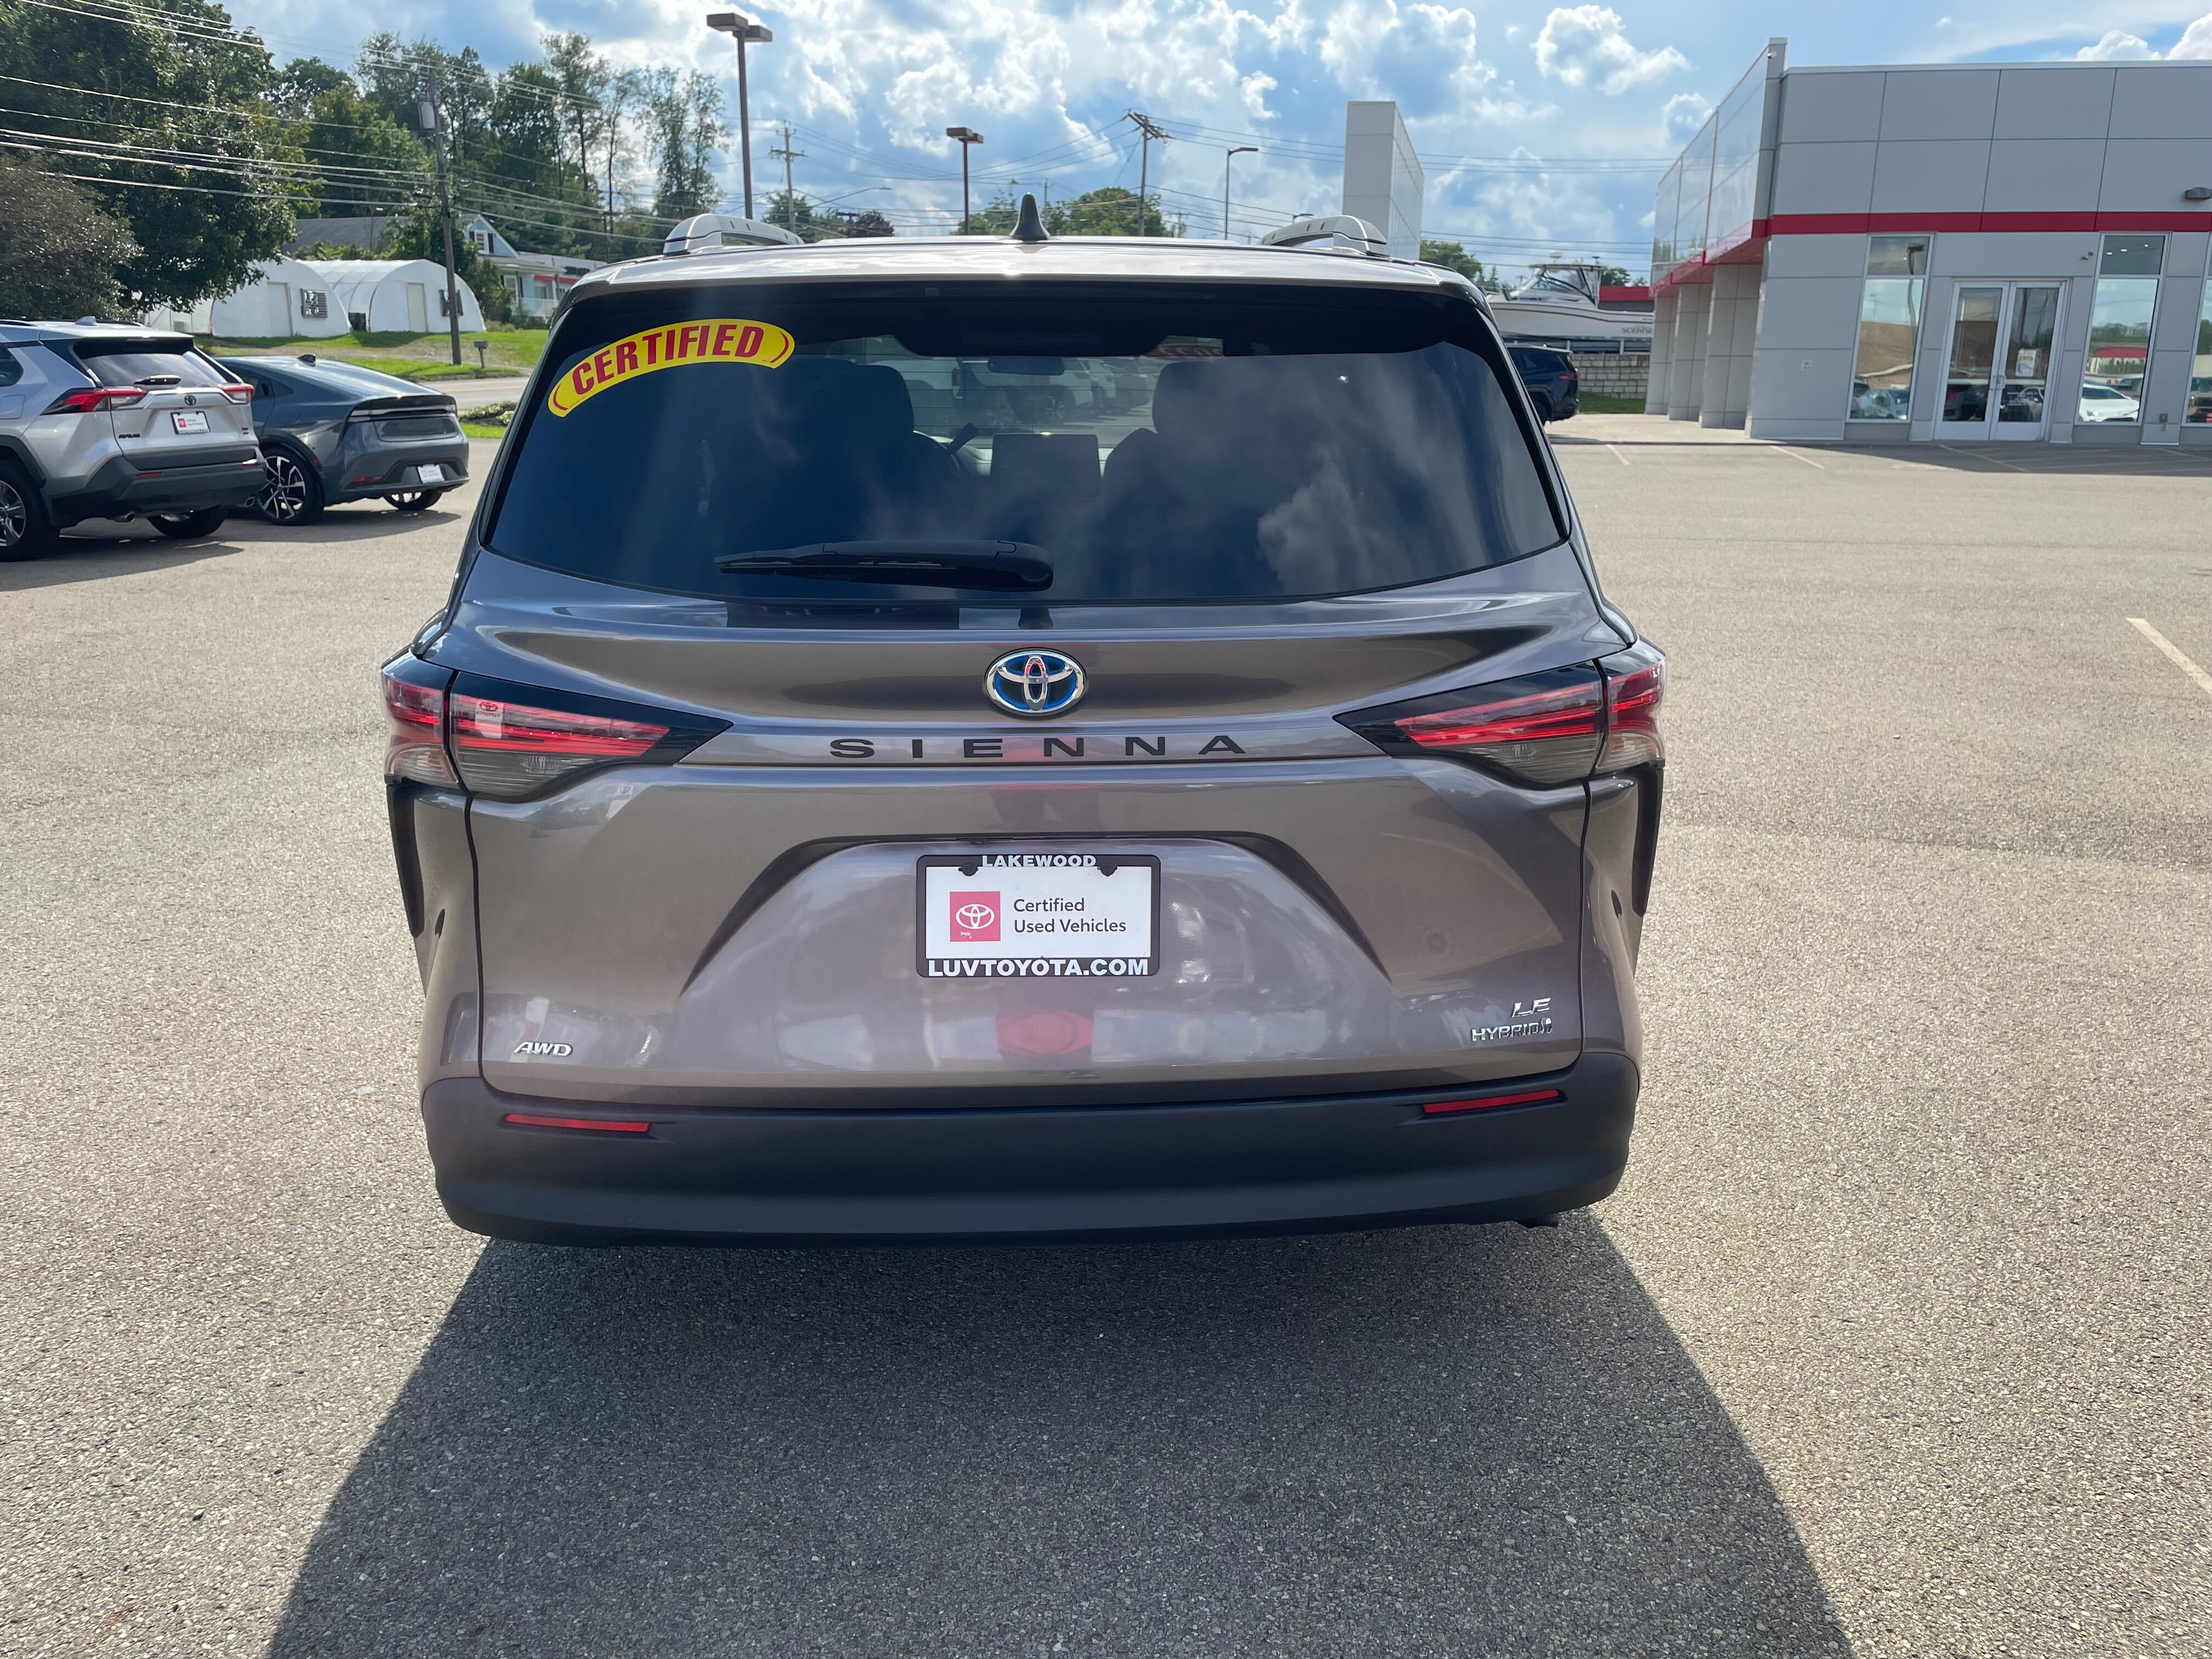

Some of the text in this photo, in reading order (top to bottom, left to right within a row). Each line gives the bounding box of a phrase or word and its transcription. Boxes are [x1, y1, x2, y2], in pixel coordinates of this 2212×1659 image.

[572, 325, 764, 395] CERTIFIED
[831, 736, 1246, 758] SIENNA
[982, 855, 1096, 867] LAKEWOOD
[1014, 898, 1085, 912] Certified
[1015, 918, 1126, 933] Used Vehicles
[928, 959, 1148, 976] LUVTOYOTA.COM
[1511, 998, 1551, 1017] LE
[1471, 1022, 1539, 1041] HYBRID
[514, 1041, 573, 1056] AWD
